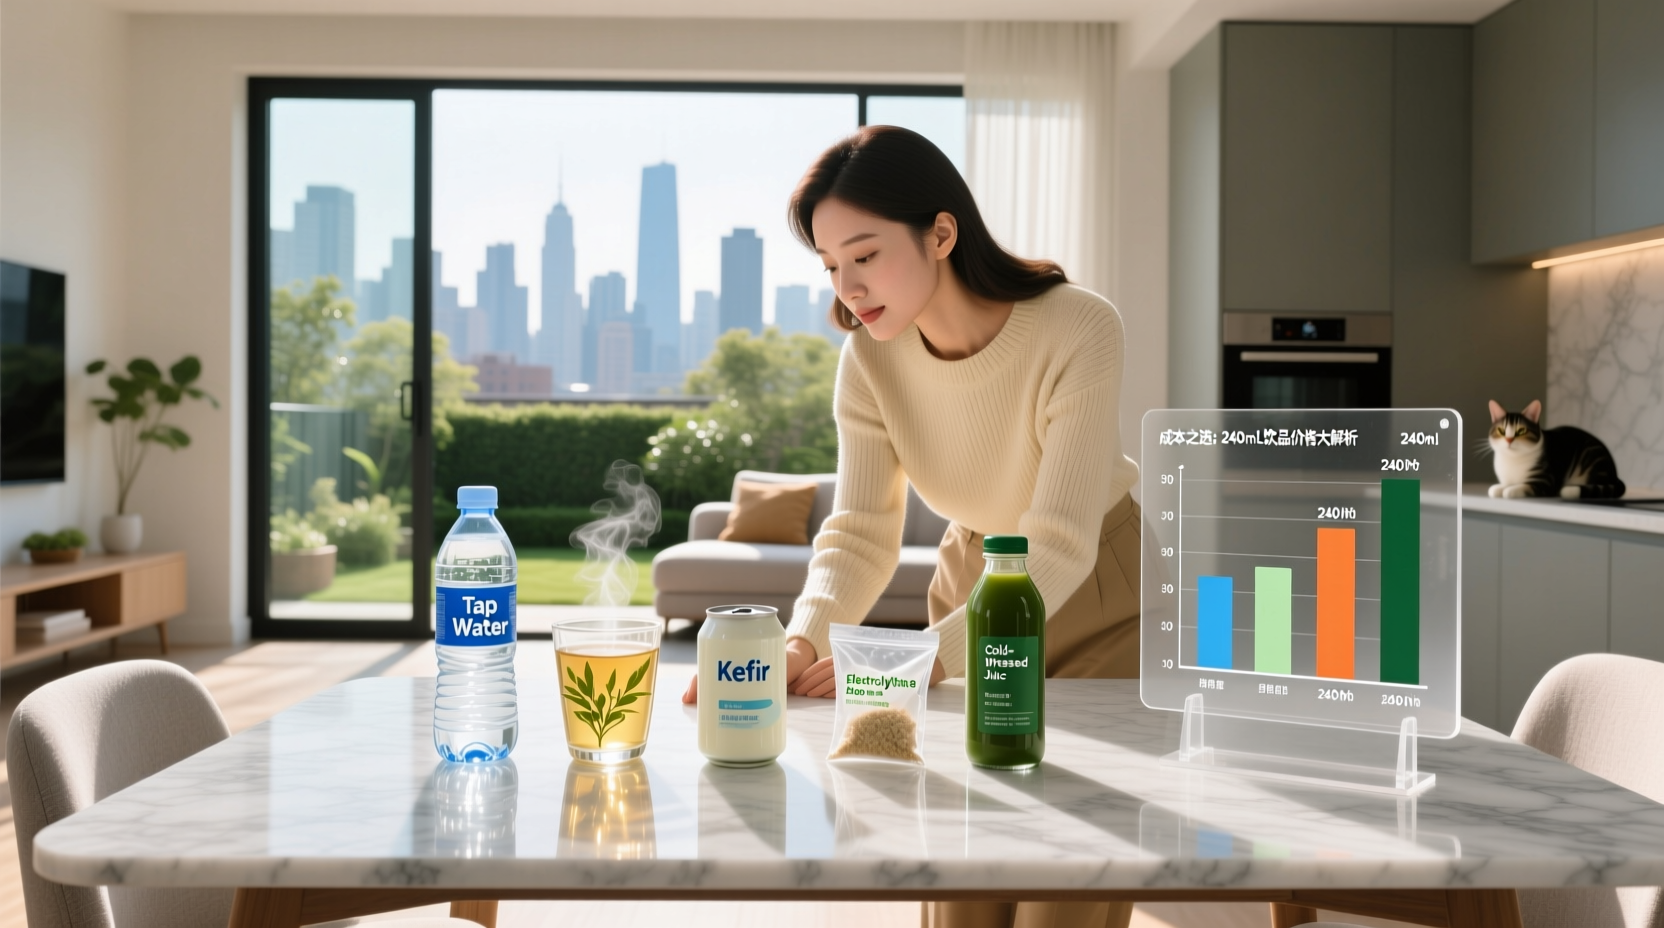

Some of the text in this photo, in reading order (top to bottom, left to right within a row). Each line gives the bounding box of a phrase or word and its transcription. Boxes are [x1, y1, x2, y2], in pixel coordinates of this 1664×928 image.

[1400, 431, 1439, 446] 240ml
[462, 596, 498, 618] Tap
[452, 617, 509, 637] Water
[718, 659, 771, 683] Kefir
